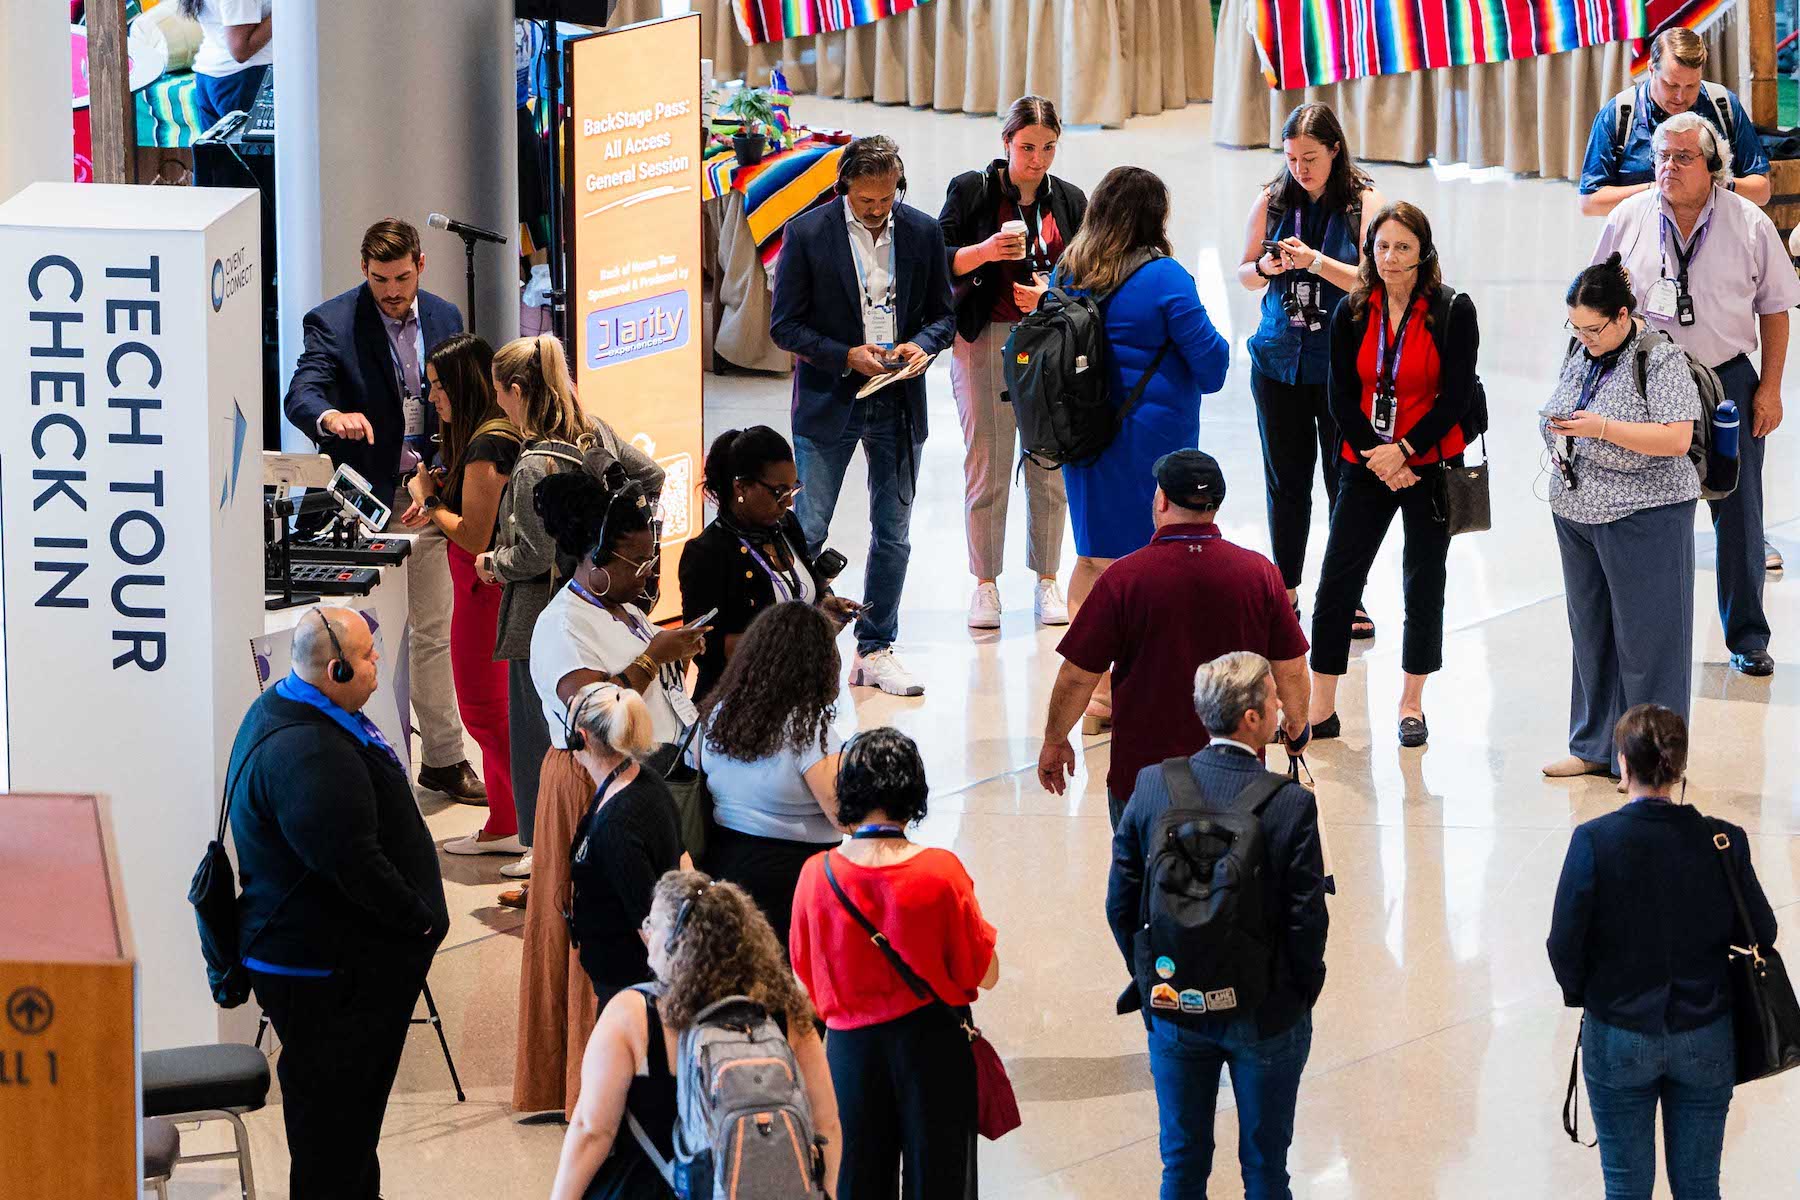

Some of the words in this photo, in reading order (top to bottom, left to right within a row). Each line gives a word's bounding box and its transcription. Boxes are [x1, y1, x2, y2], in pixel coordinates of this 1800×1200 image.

[583, 109, 652, 137] BackStage
[655, 99, 691, 121] Pass:
[604, 139, 622, 161] All
[625, 132, 671, 155] Access
[586, 163, 636, 192] General
[638, 155, 689, 180] Session
[226, 247, 245, 275] CVENT
[678, 267, 689, 280] by
[226, 264, 253, 298] CONNECT
[106, 256, 162, 444] TECH
[607, 337, 664, 357] experiences
[28, 255, 87, 511] CHECK
[34, 538, 88, 608] IN
[110, 470, 166, 671] TOUR
